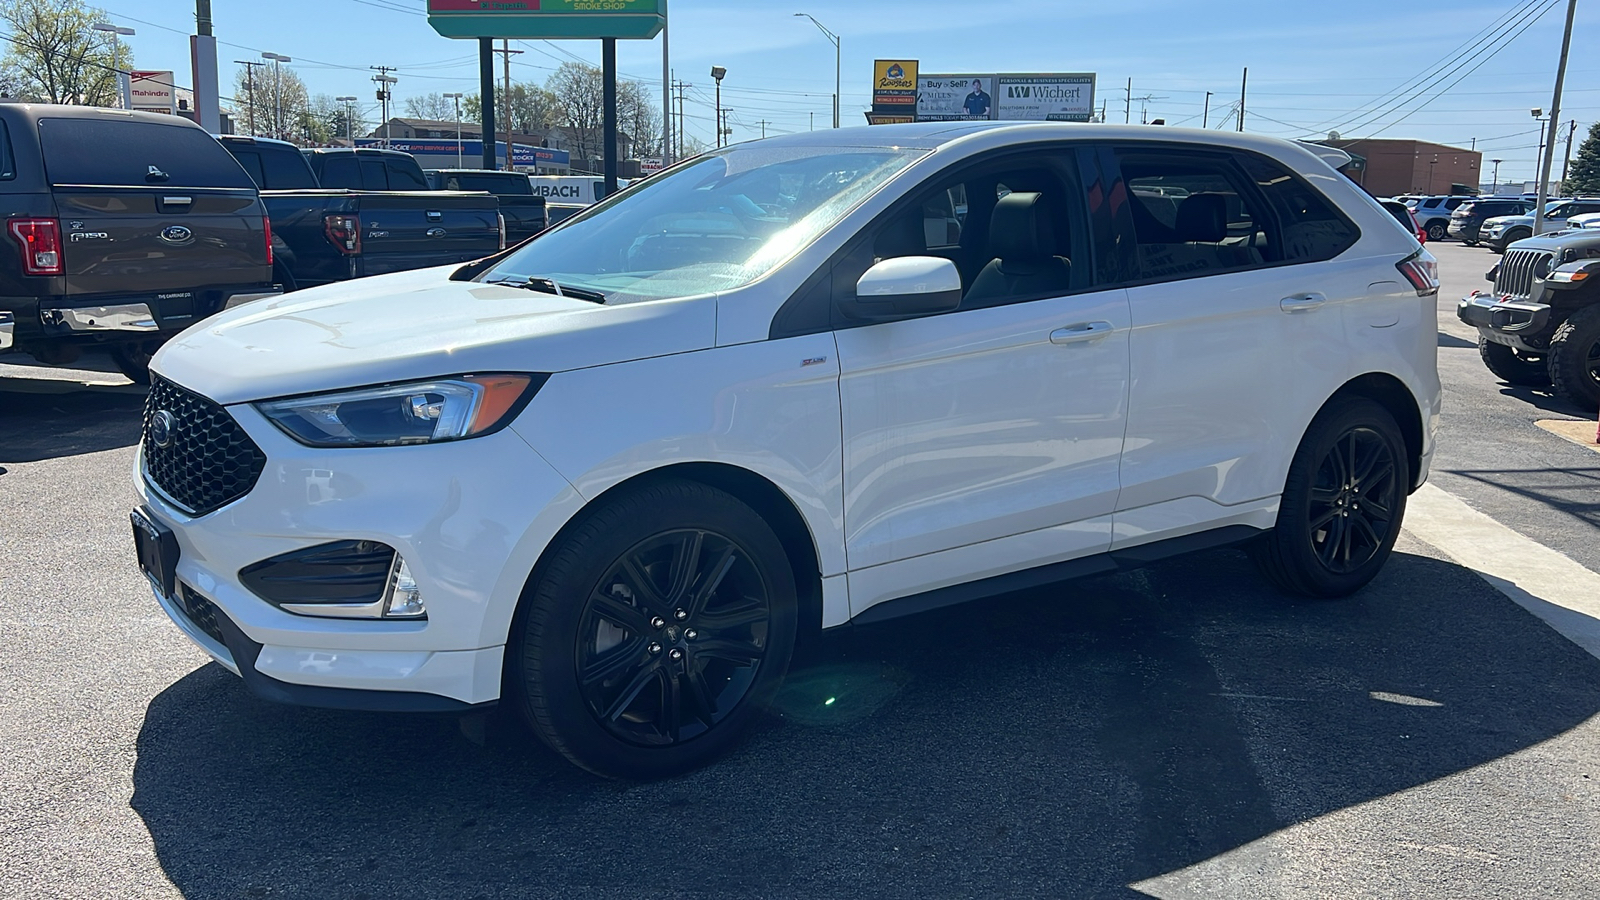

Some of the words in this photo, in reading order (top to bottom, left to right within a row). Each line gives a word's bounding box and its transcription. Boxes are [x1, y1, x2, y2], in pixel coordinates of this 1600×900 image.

[573, 2, 602, 10] SMOKE
[602, 2, 626, 10] SHOP
[879, 77, 913, 89] Roosters
[927, 80, 942, 89] Buy
[949, 80, 968, 88] Sell?
[1032, 85, 1081, 99] Wichert
